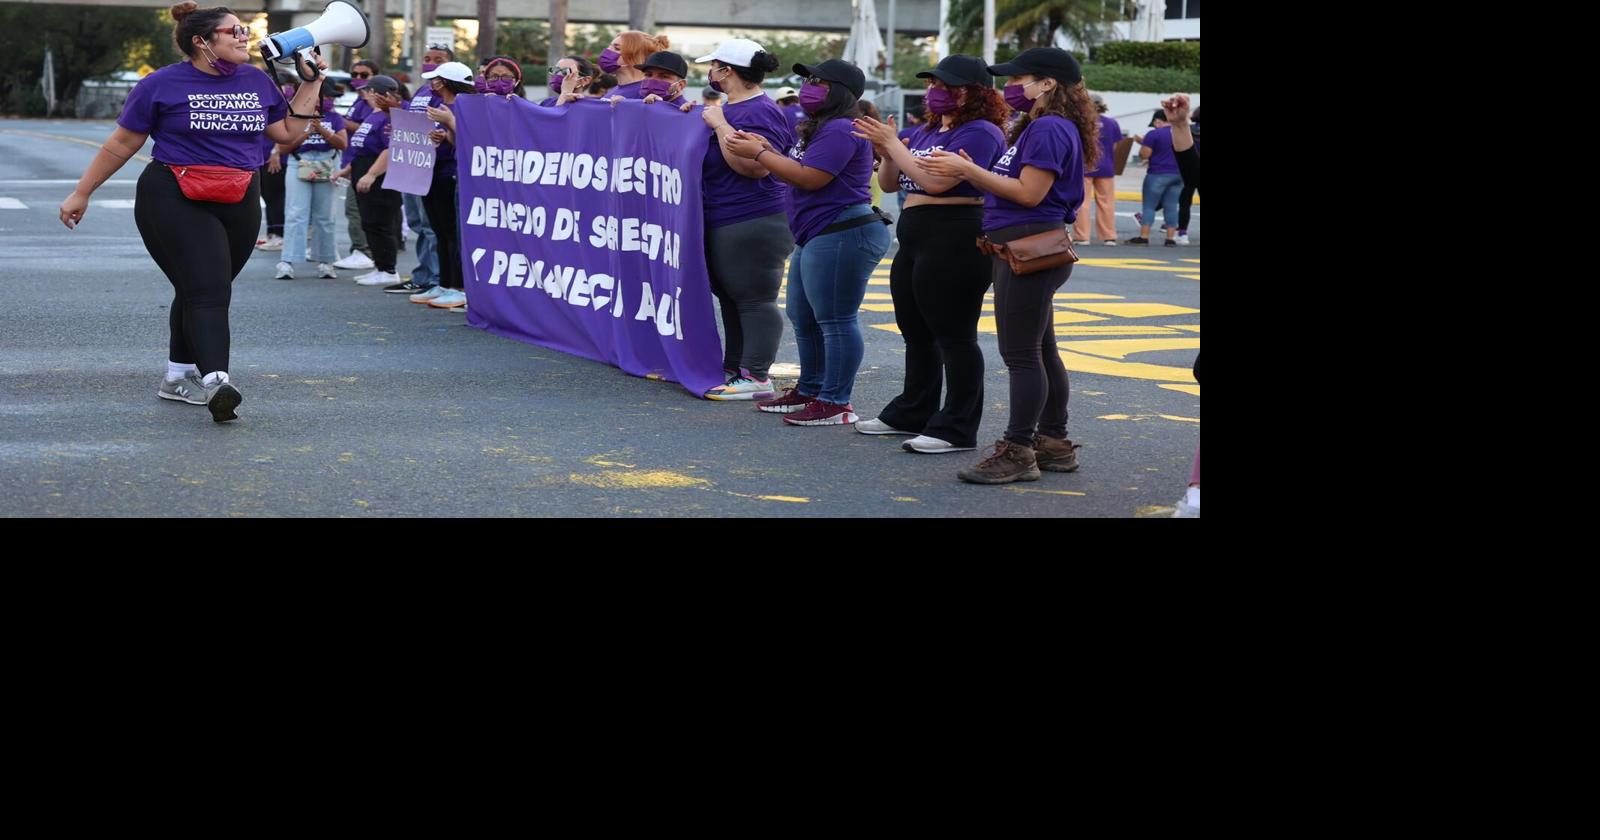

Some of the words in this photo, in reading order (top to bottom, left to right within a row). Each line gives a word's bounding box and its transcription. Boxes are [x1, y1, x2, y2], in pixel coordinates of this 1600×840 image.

[189, 100, 263, 109] OCUPAMOS
[190, 112, 265, 122] DESPLAZADAS
[190, 120, 238, 131] NUNCA
[242, 121, 265, 131] MÁS
[393, 129, 402, 142] SE
[403, 131, 420, 145] NOS
[391, 147, 404, 164] LA
[407, 149, 432, 169] VIDA
[610, 156, 682, 206] NESTRO
